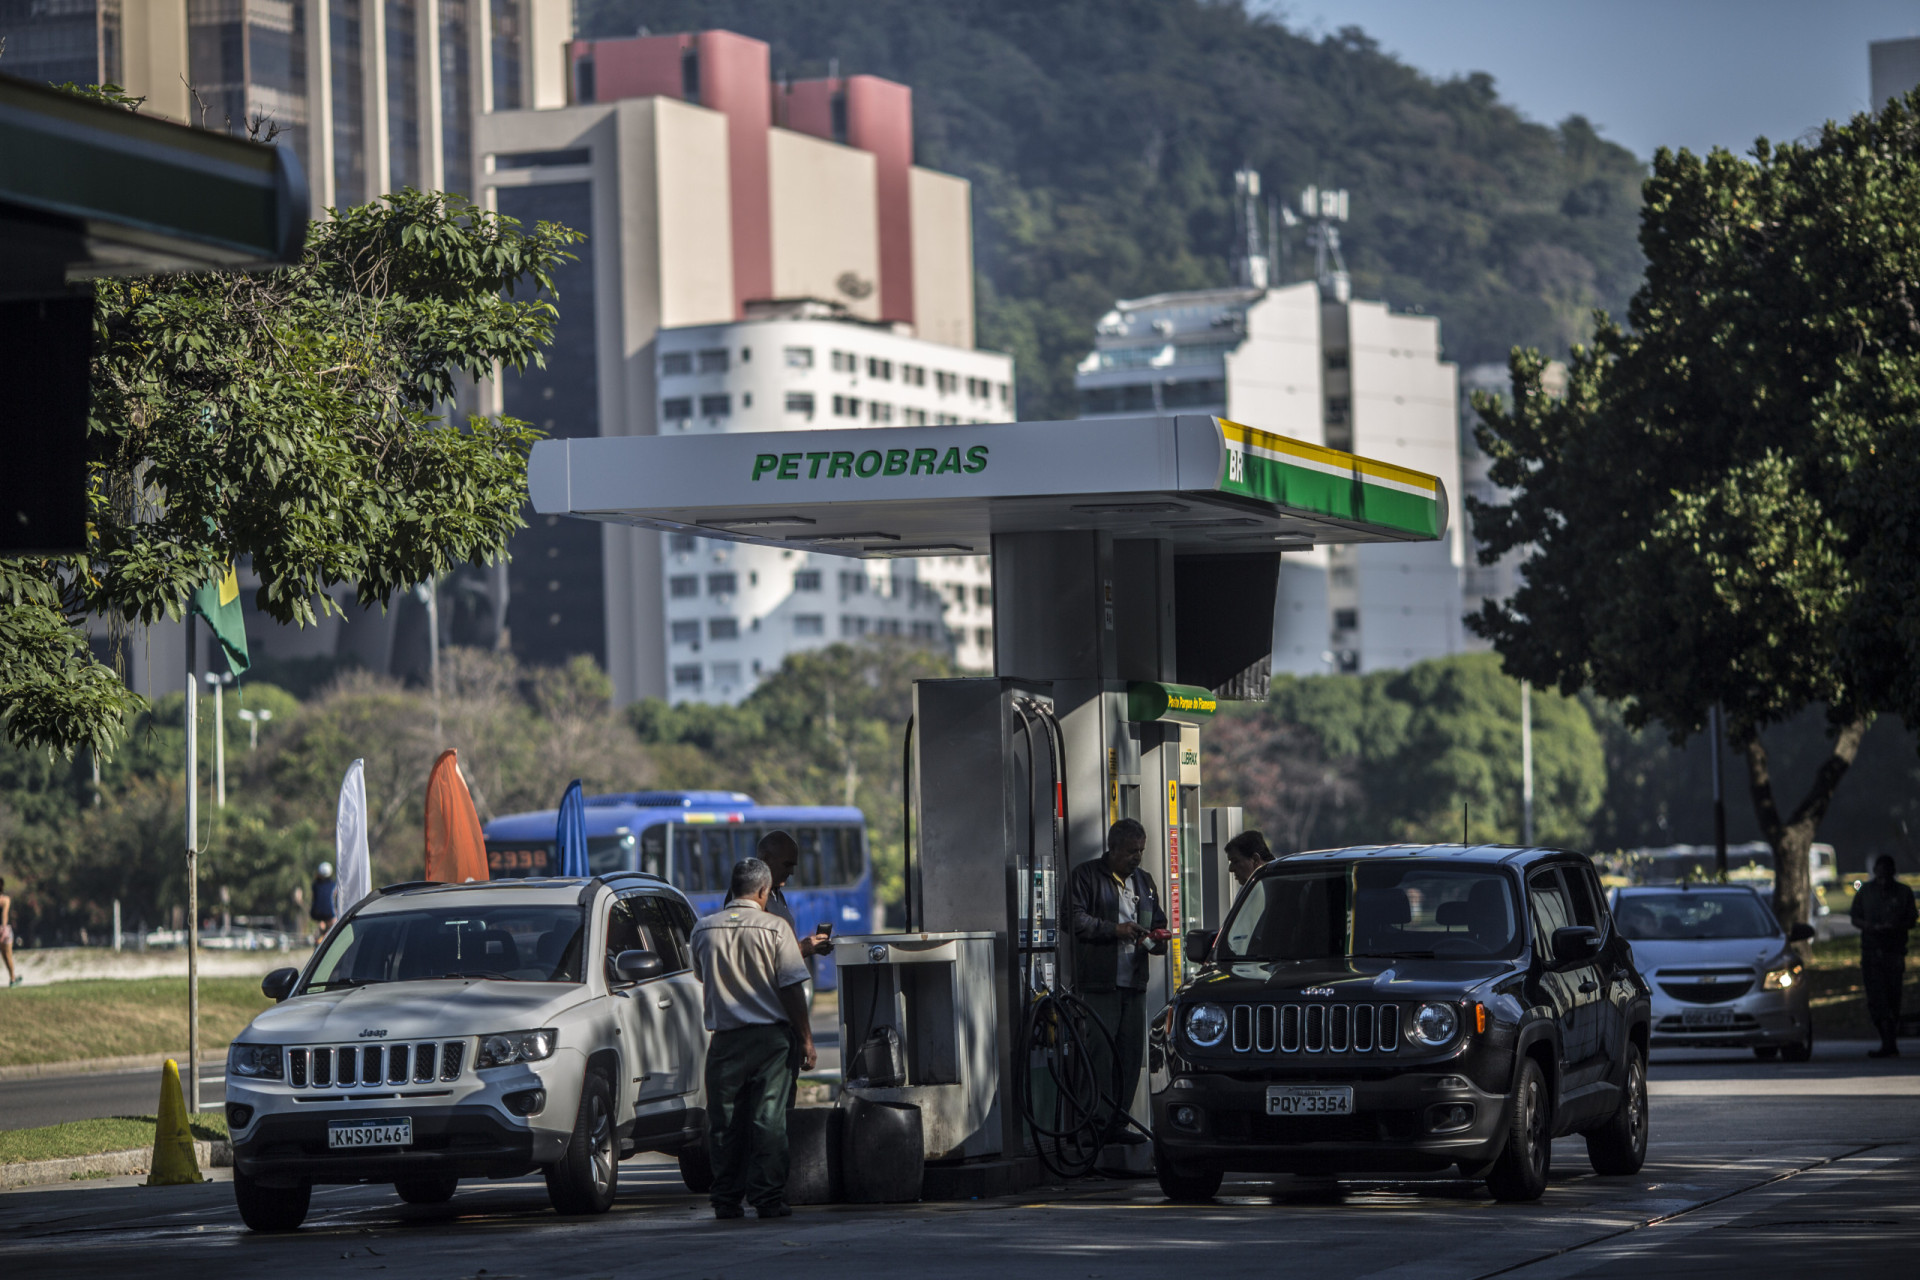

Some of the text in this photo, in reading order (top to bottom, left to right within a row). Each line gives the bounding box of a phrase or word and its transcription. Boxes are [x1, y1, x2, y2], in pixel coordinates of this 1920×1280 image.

[751, 445, 989, 481] PETROBRAS
[1229, 448, 1244, 484] BR
[1181, 751, 1197, 766] LUBRAX
[1300, 987, 1334, 997] Jeep
[359, 1028, 388, 1038] Jeep
[335, 1127, 402, 1146] KWS9C46
